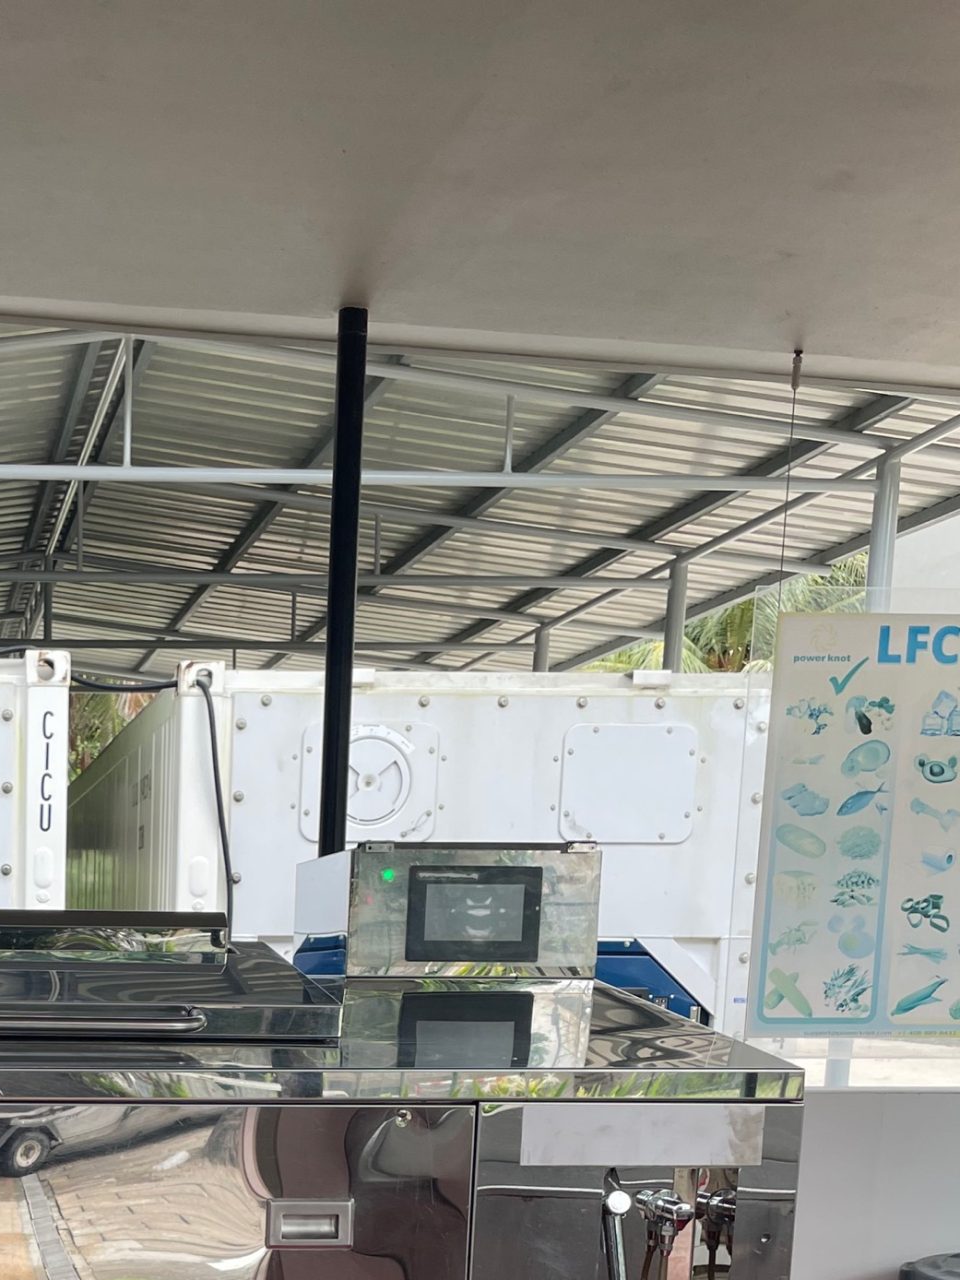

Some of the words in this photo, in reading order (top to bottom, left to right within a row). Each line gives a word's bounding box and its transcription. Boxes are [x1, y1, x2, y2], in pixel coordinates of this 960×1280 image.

[793, 655, 826, 664] power
[827, 654, 851, 663] knot
[877, 625, 960, 664] LFC
[40, 711, 54, 832] CICU
